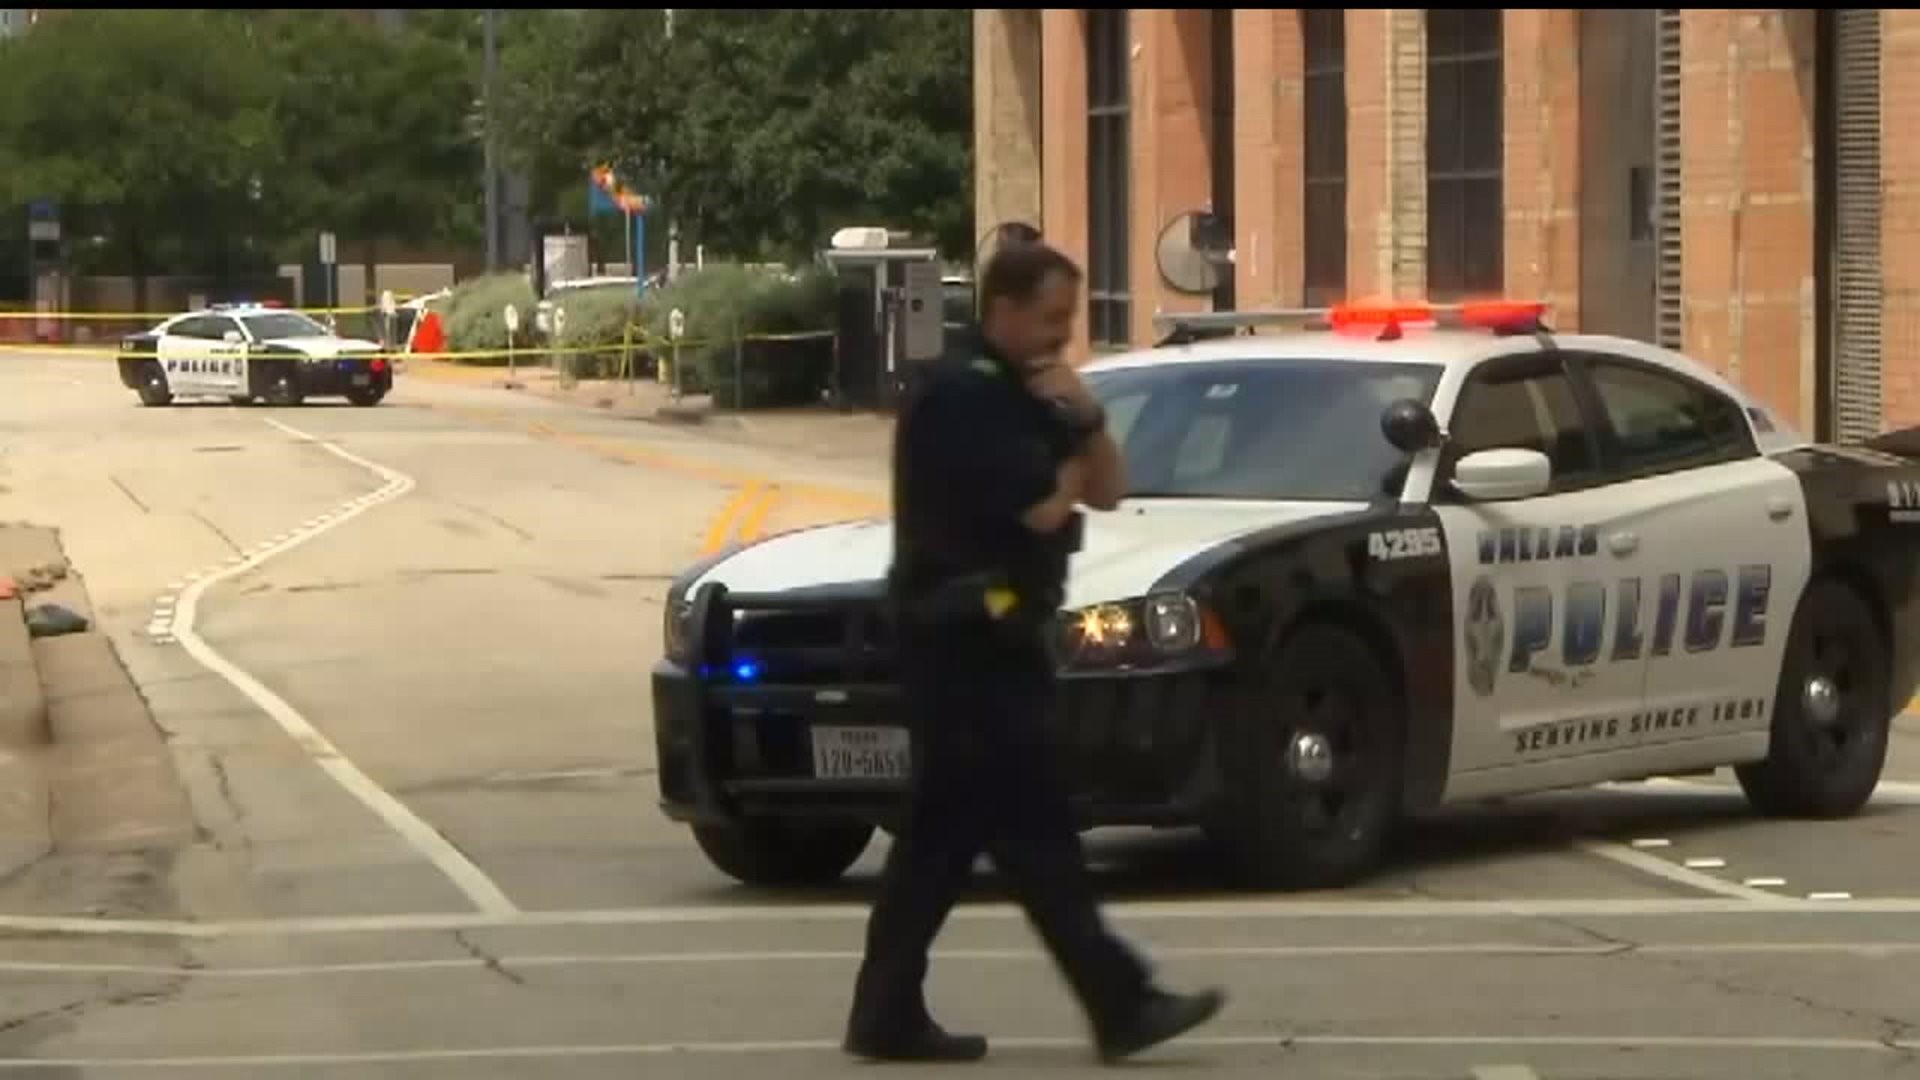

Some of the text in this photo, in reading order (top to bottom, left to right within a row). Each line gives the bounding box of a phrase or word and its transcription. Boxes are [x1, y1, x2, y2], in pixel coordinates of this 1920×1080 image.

[1367, 528, 1441, 561] 4295
[1509, 564, 1771, 672] POLICE
[1515, 719, 1619, 753] SERVING
[1629, 707, 1699, 733] SINCE
